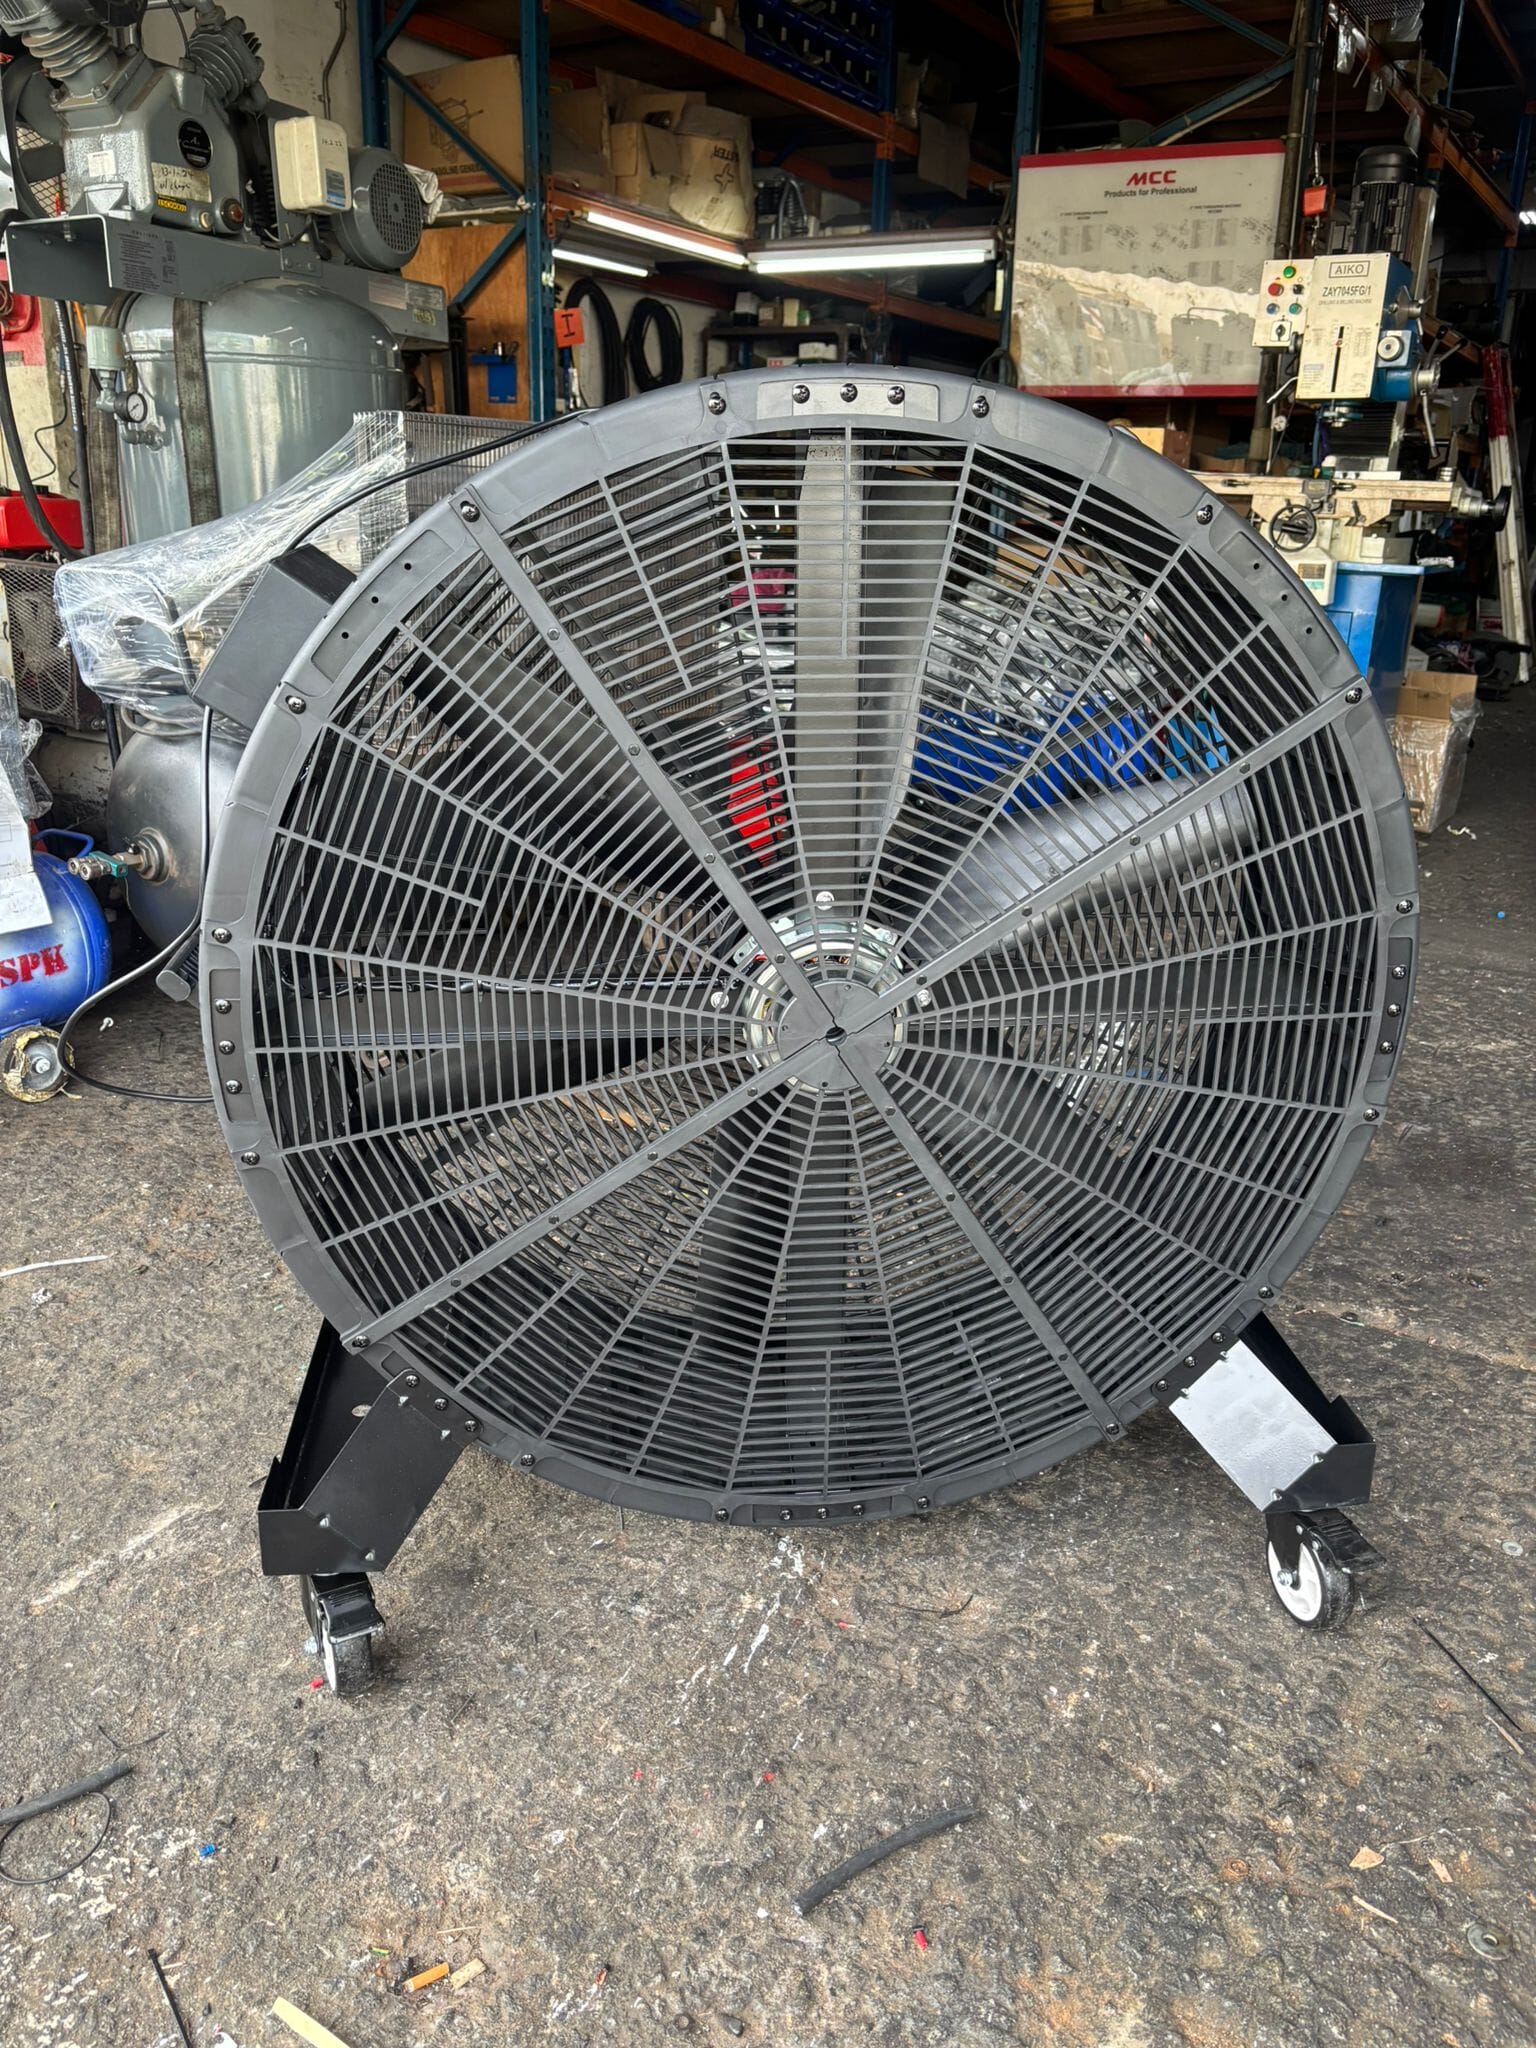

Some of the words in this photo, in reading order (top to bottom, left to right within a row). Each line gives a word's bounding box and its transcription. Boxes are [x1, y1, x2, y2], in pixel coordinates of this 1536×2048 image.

[1126, 170, 1177, 187] MCC
[1104, 189, 1137, 198] Products
[1139, 188, 1149, 196] for
[1150, 186, 1198, 196] Professional
[1335, 264, 1364, 275] AIKO
[0, 944, 69, 989] SPK
